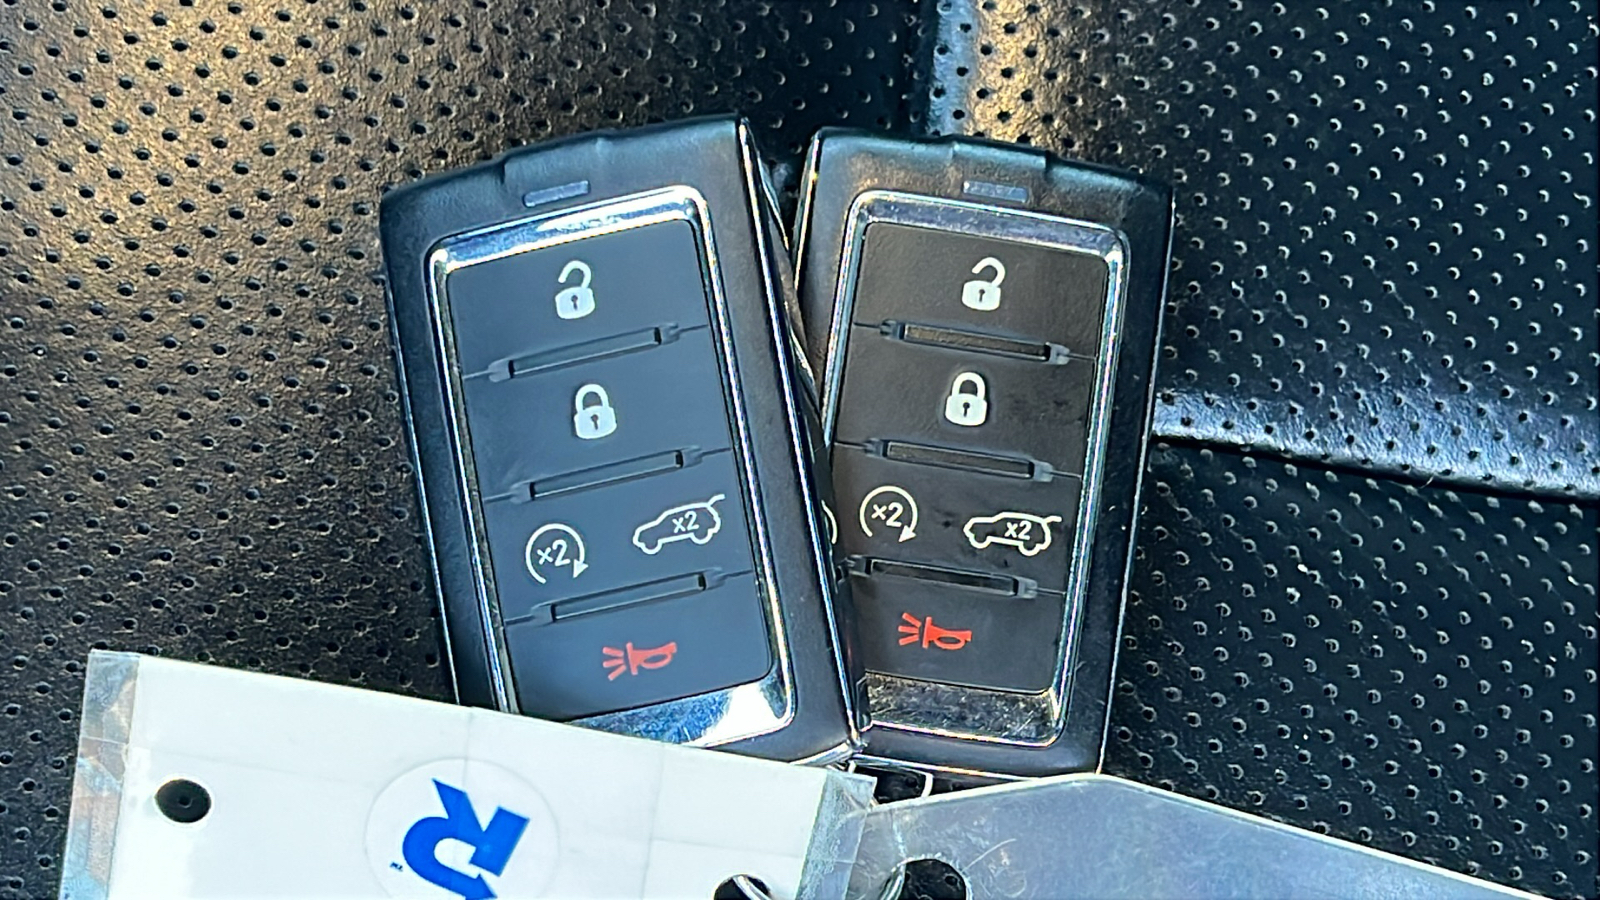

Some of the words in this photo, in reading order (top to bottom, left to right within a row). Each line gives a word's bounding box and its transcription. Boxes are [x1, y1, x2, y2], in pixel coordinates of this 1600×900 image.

[672, 510, 700, 534] x2
[871, 501, 904, 528] x2
[1004, 519, 1033, 541] x2
[537, 539, 571, 567] x2
